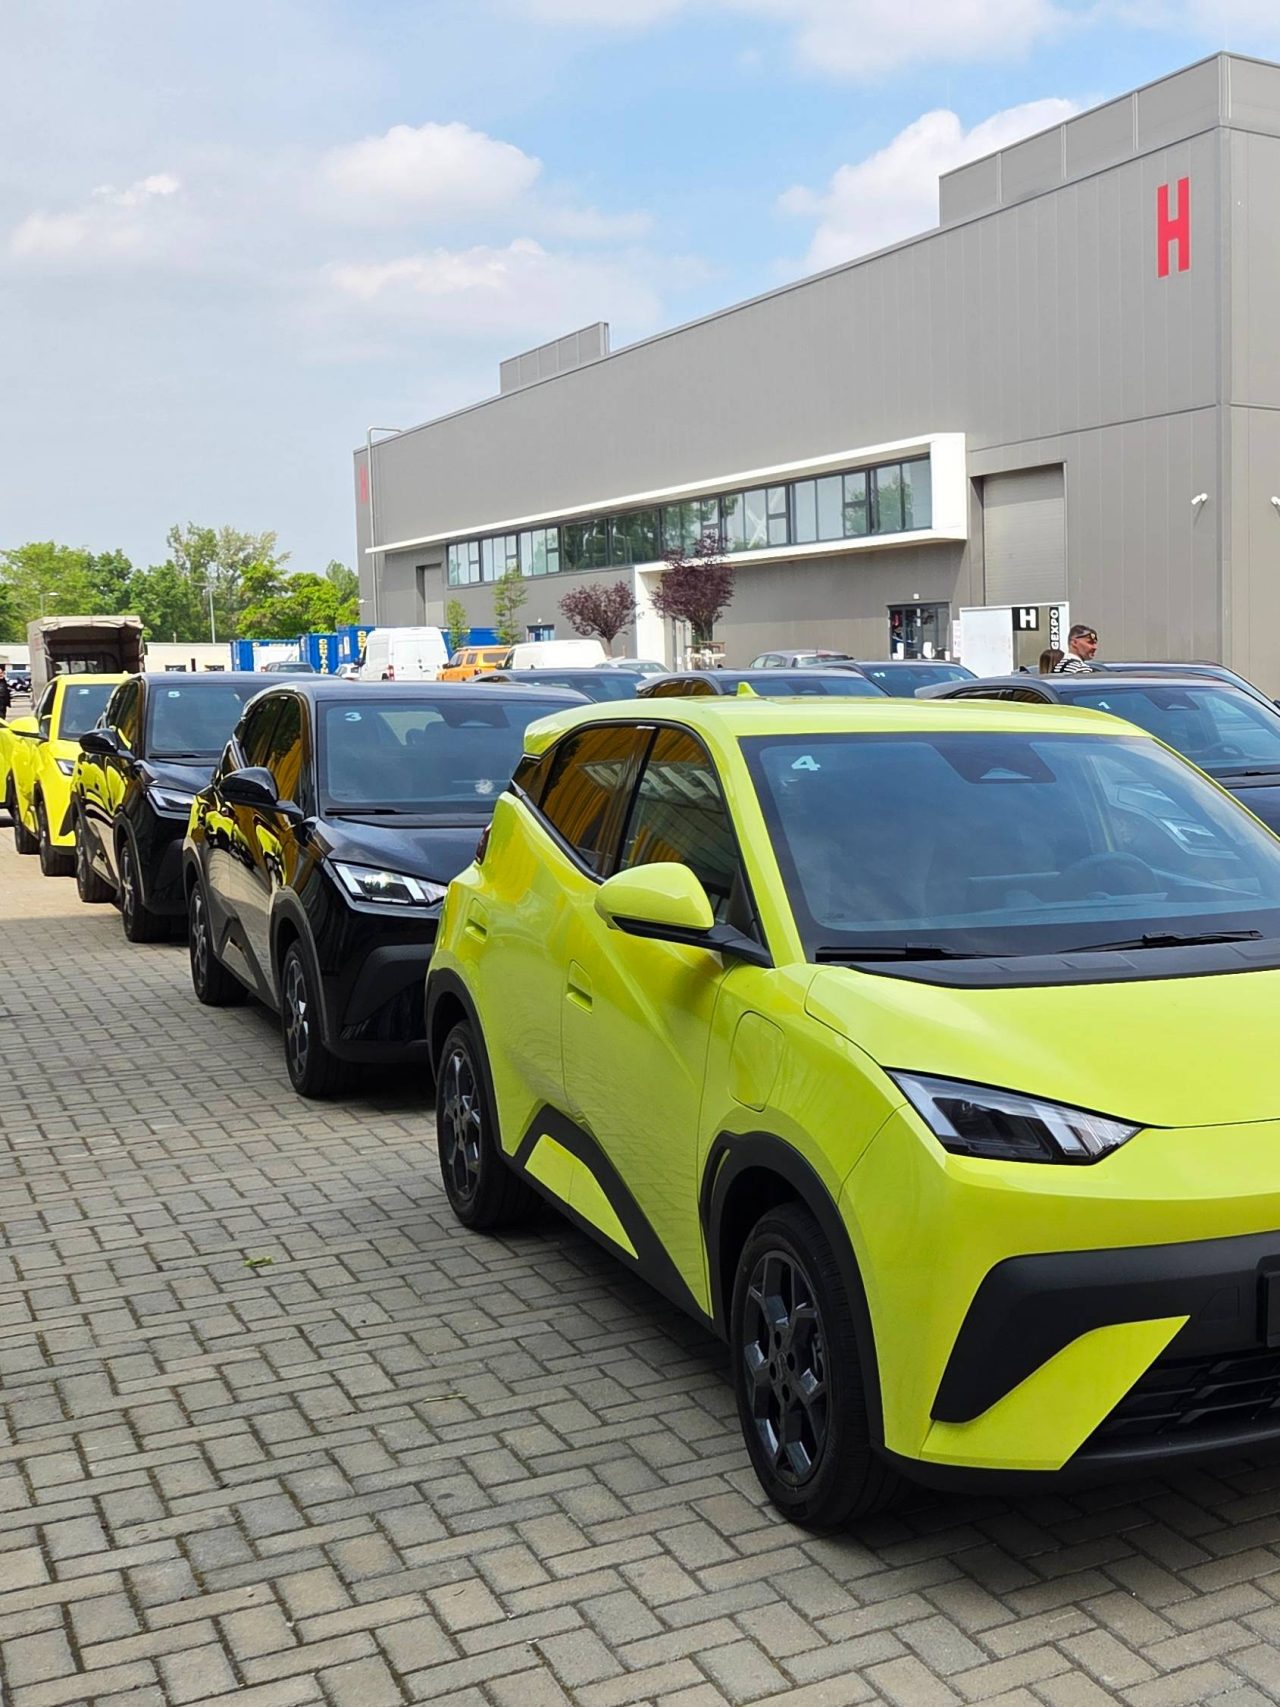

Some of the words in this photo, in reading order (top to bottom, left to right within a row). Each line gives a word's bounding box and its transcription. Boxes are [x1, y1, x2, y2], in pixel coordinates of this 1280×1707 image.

[1157, 176, 1190, 279] H
[1019, 608, 1037, 629] H
[344, 712, 362, 722] 3
[791, 755, 821, 771] 4
